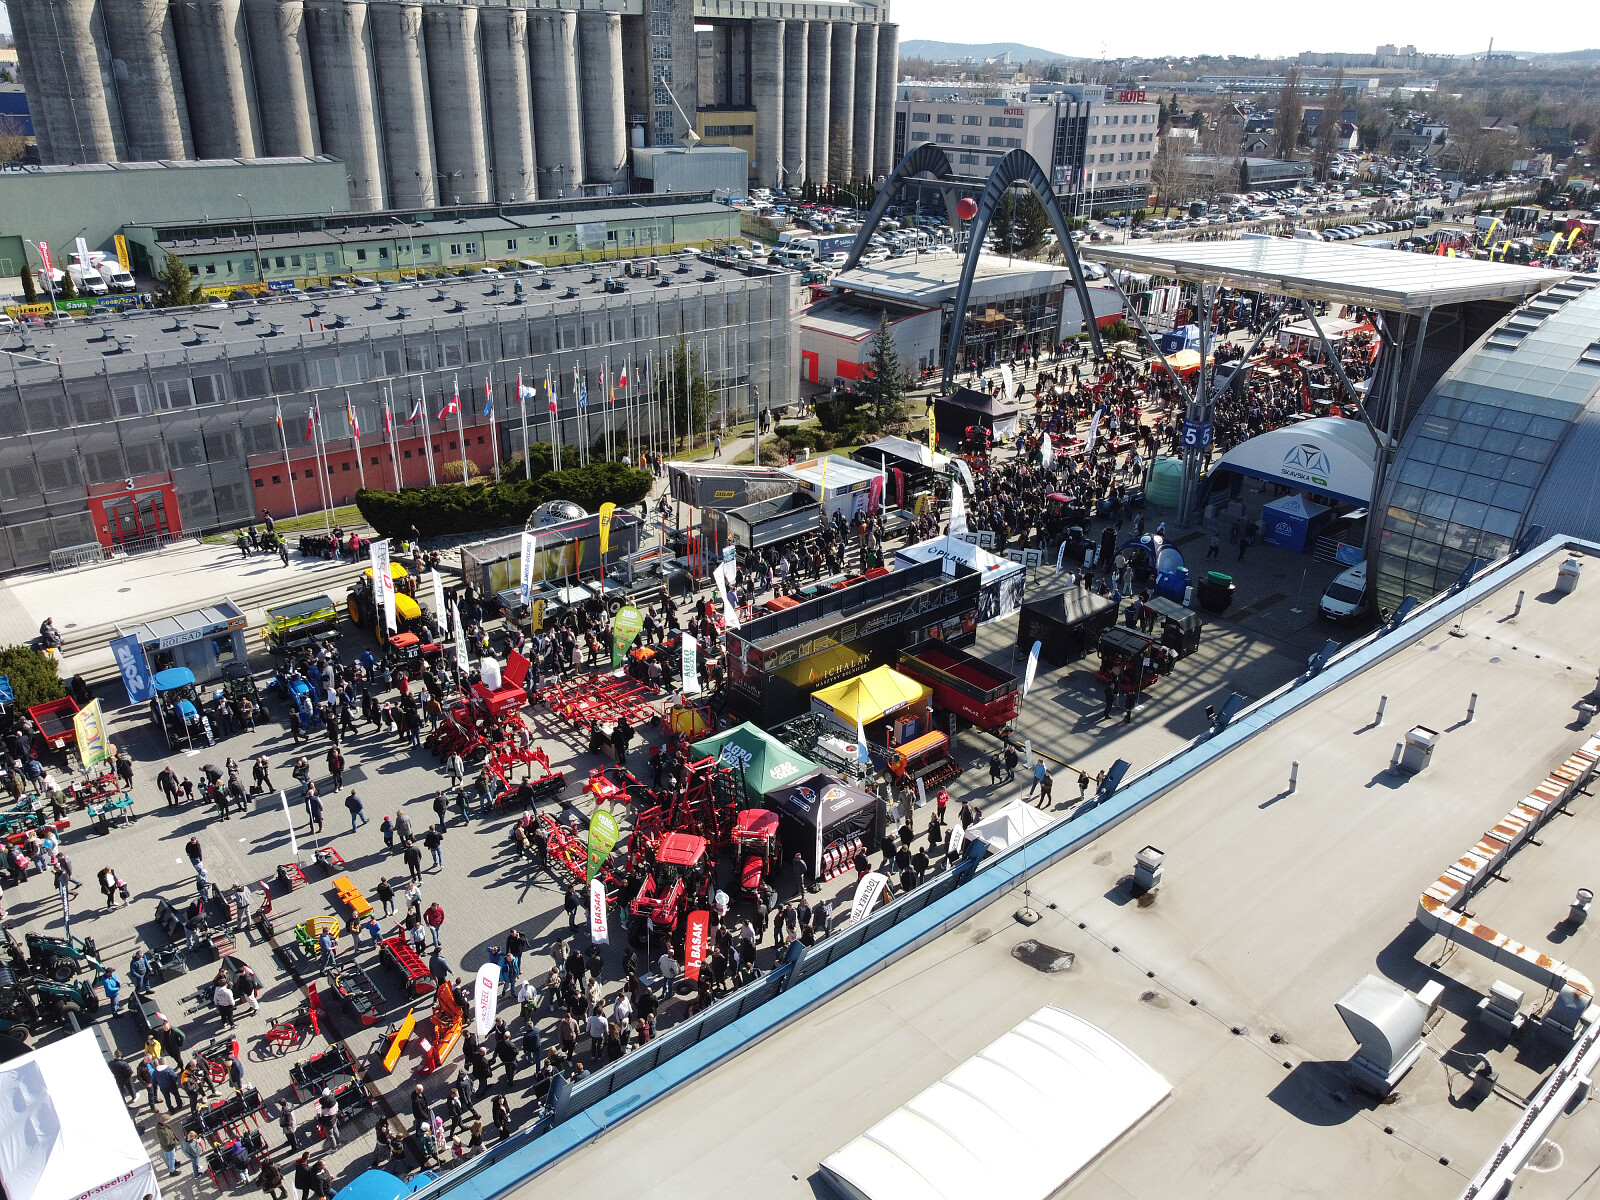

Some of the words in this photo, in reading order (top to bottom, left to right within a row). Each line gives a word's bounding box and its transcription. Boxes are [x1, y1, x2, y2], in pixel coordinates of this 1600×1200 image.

[1120, 90, 1147, 103] HOTEL
[1003, 108, 1025, 116] HOTEL
[1184, 428, 1197, 445] 5
[1202, 428, 1210, 445] 5
[1281, 468, 1310, 481] SKAVSKA
[124, 478, 135, 491] 3
[936, 549, 968, 566] PILANA
[376, 542, 388, 598] ROSAD
[229, 619, 245, 627] JCB
[162, 631, 201, 648] ROLSAD
[723, 741, 753, 762] AGRO
[857, 877, 876, 910] TOOLMEX
[690, 921, 703, 958] BASAK
